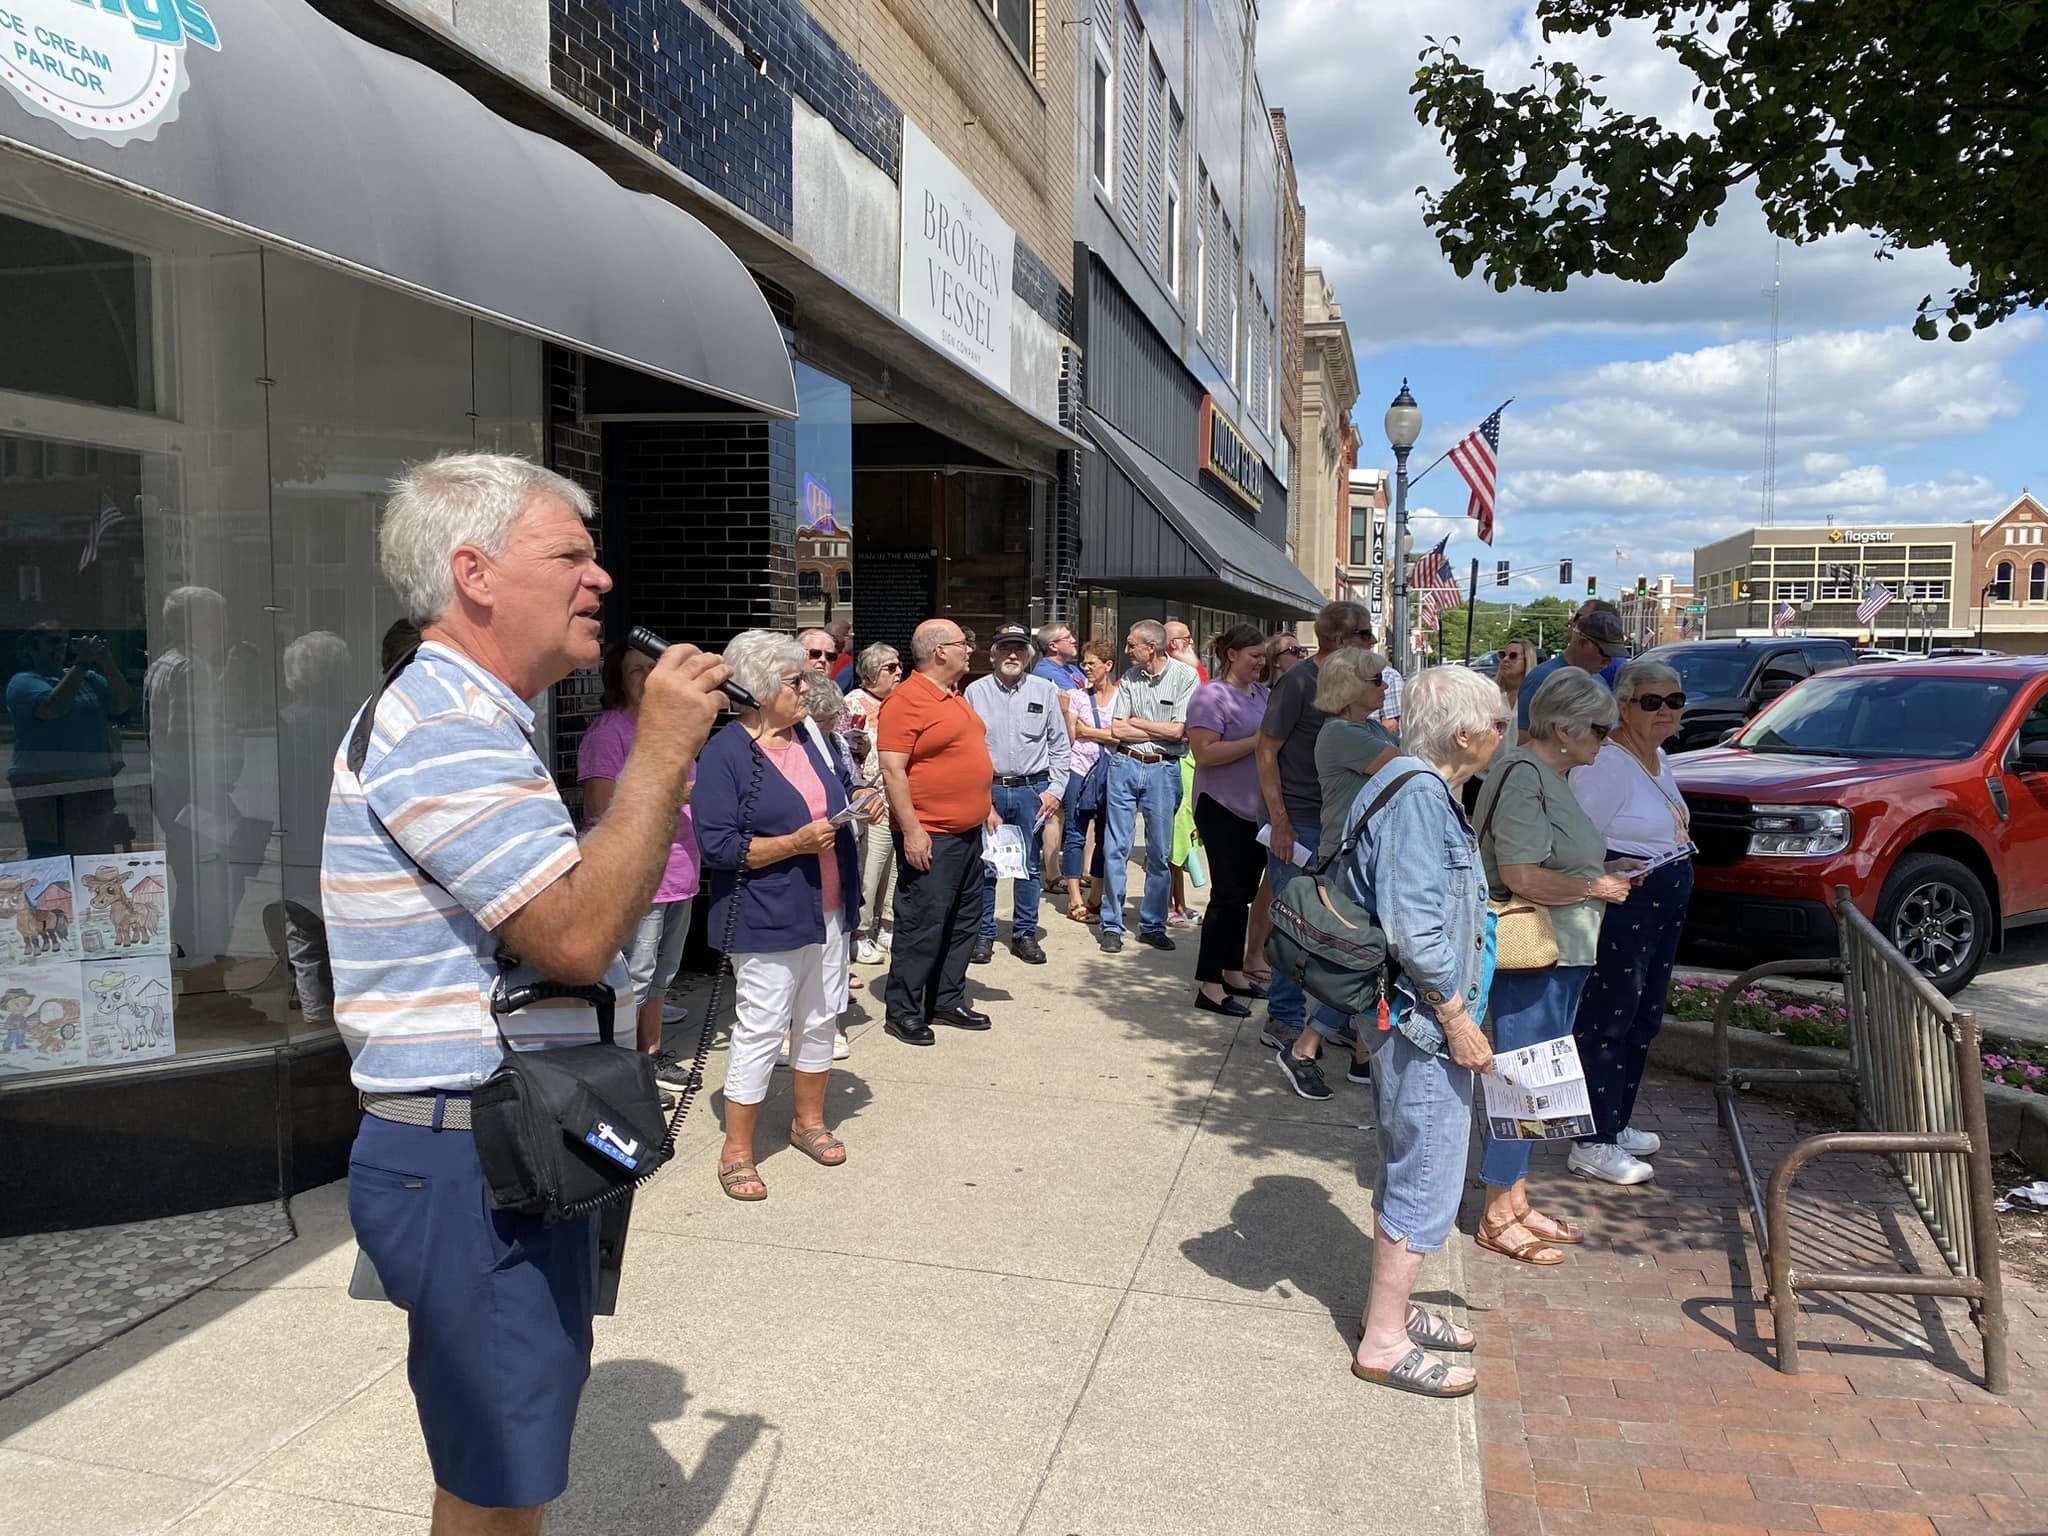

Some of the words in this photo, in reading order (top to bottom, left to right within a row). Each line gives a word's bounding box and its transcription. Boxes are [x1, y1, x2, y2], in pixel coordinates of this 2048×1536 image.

[0, 9, 28, 37] CE
[34, 26, 113, 73] CREAM
[13, 41, 105, 95] PARLOR
[923, 188, 1000, 298] BROKEN
[928, 256, 995, 353] VESSEL
[1373, 523, 1384, 564] VAC
[1845, 530, 1896, 544] flagstar
[1372, 572, 1383, 612] SEW
